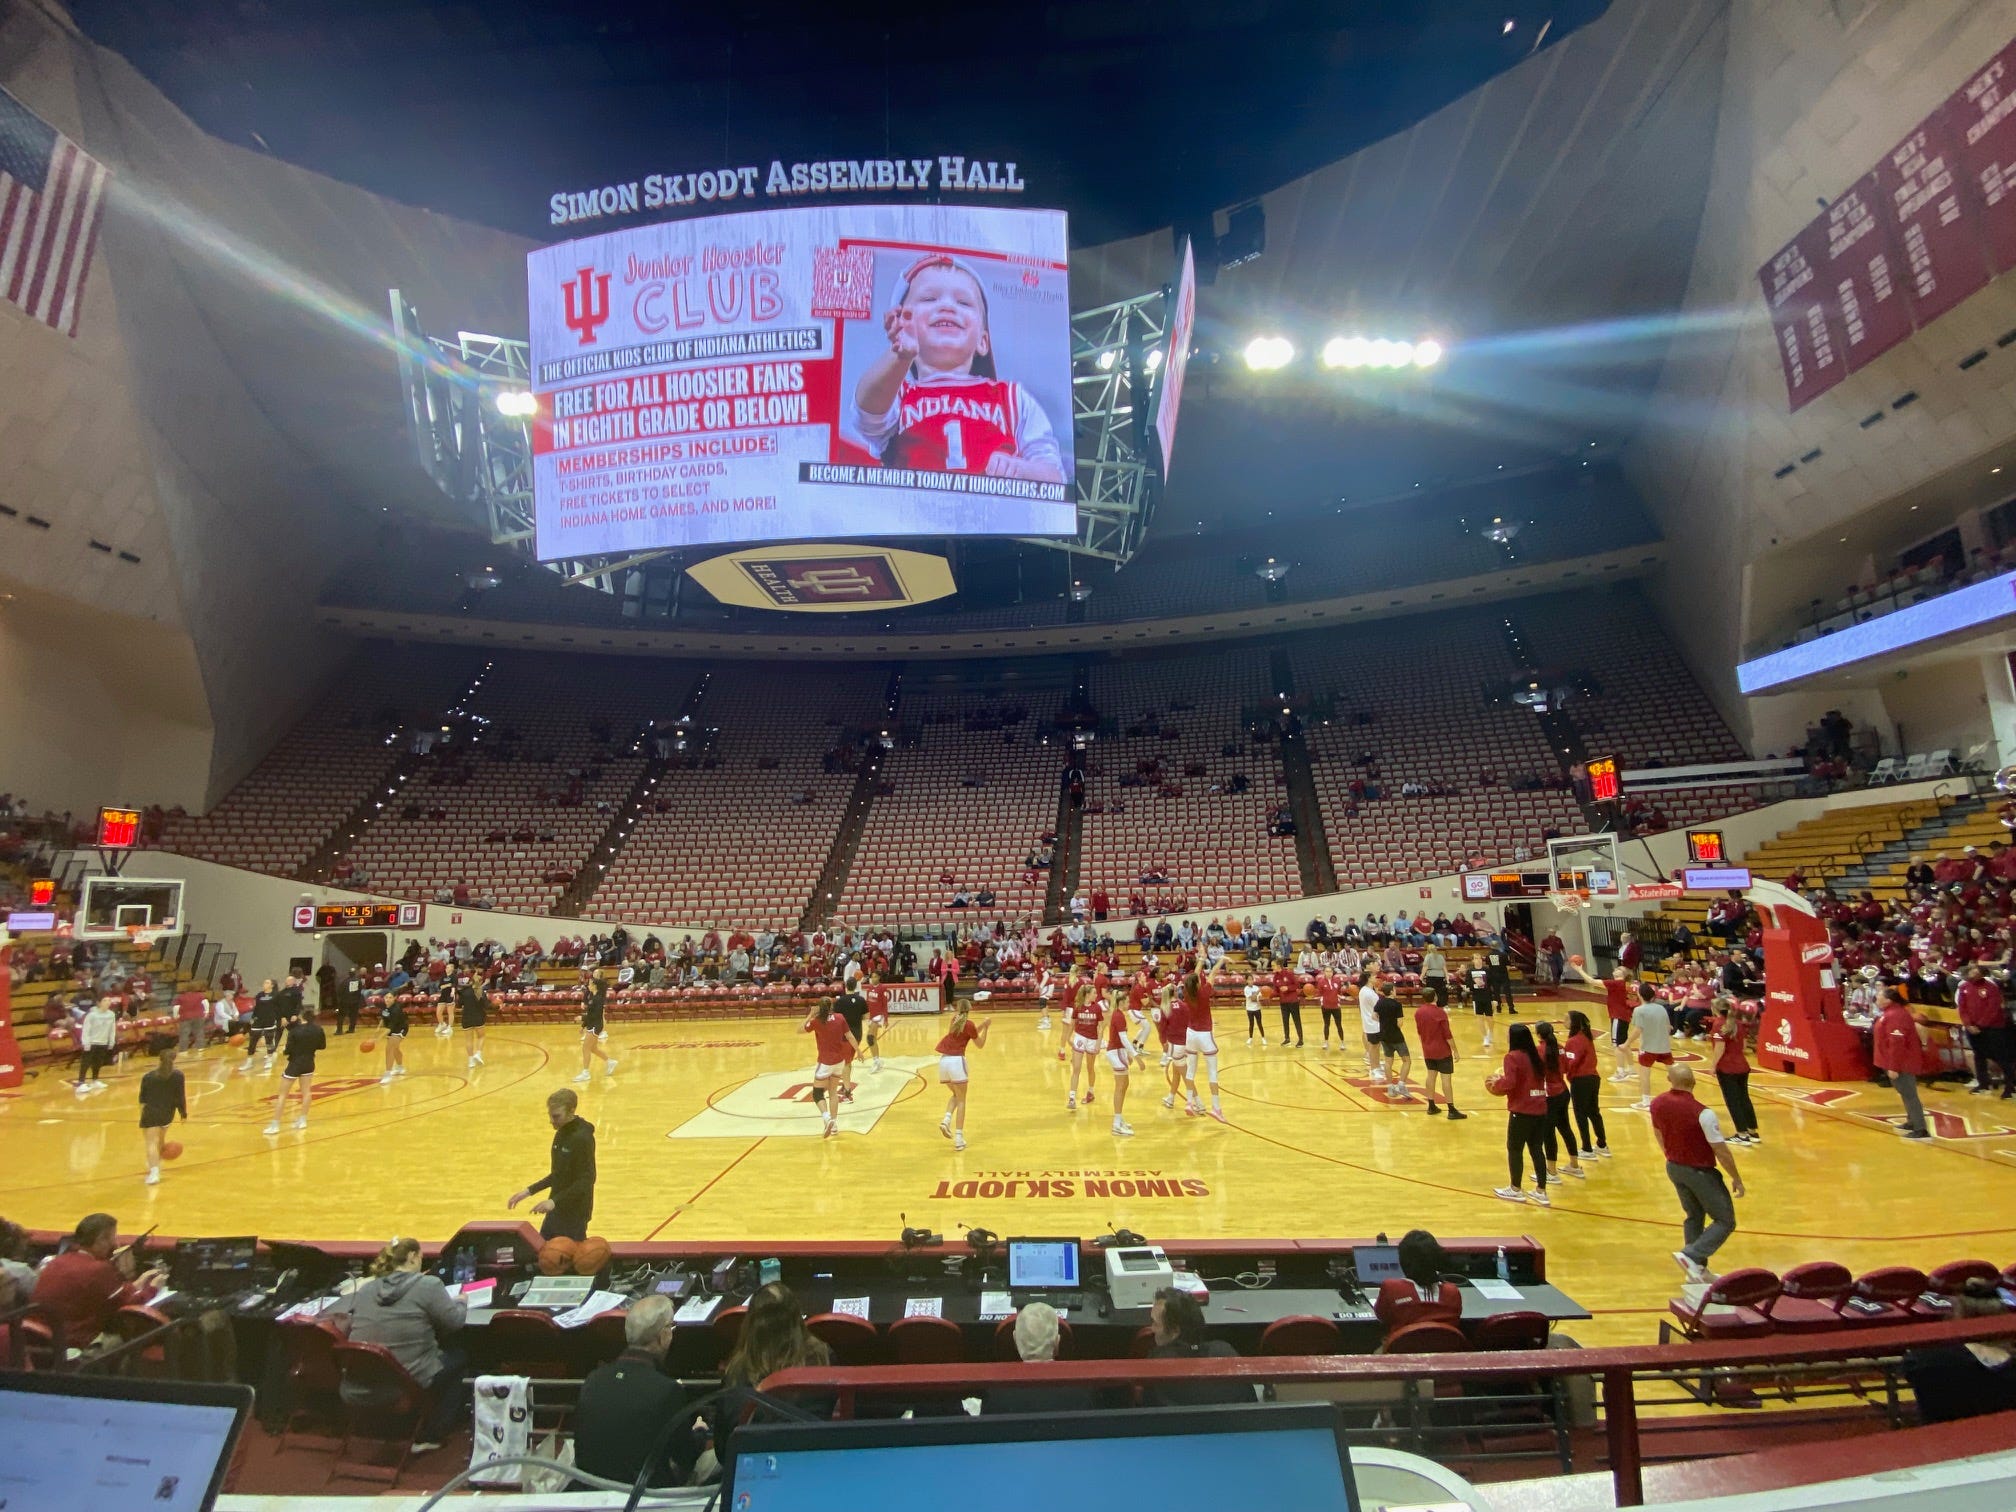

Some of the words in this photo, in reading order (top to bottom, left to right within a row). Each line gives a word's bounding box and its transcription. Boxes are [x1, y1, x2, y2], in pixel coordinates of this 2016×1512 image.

[550, 181, 638, 225] SIMON
[643, 166, 758, 209] SKJODT
[765, 160, 932, 194] ASSEMBLY
[938, 156, 1024, 192] HALL
[624, 251, 694, 285] Junior
[702, 239, 786, 273] Hoosier
[633, 267, 784, 334] CLUB
[542, 364, 563, 382] THE
[564, 357, 612, 378] OFFICIAL
[613, 350, 641, 369] KIDS
[643, 344, 674, 363] CLUB
[676, 341, 693, 359] OF
[693, 336, 747, 358] INDIANA
[747, 330, 817, 352] ATHLETICS
[554, 385, 595, 417] FREE
[595, 380, 629, 411] FOR
[631, 375, 663, 405] ALL
[665, 367, 749, 402] HOOSIER
[752, 362, 804, 393] FANS
[553, 422, 570, 449] IN
[573, 411, 635, 446] EIGHTH
[638, 402, 700, 439] GRADE
[703, 399, 731, 428] OR
[735, 393, 808, 427] BELOW!
[558, 443, 682, 475] MEMBERSHIPS
[688, 436, 776, 457] INCLUDE:
[943, 420, 967, 470] 1
[616, 464, 677, 485] BIRTHDAY
[809, 464, 856, 483] BECOME
[856, 467, 866, 484] A
[866, 468, 914, 487] MEMBER
[915, 471, 953, 490] TODAY
[952, 474, 969, 491] AT
[969, 475, 1066, 501] IUHOOSIERS.COM
[560, 496, 587, 511] FREE
[590, 487, 640, 506] TICKETS
[641, 485, 659, 500] TO
[662, 481, 711, 498] SELECT
[560, 511, 608, 529] INDIANA
[609, 506, 647, 523] HOME
[701, 499, 729, 513] AND
[732, 496, 777, 511] MORE!
[750, 563, 799, 604] HEALTH
[887, 988, 929, 1002] DIANA
[1765, 1041, 1809, 1059] Smithville
[928, 1179, 1075, 1199] SKJODT
[973, 1170, 1030, 1178] HALL
[1040, 1170, 1163, 1178] ASSEMBLY
[1084, 1179, 1210, 1198] SIMON
